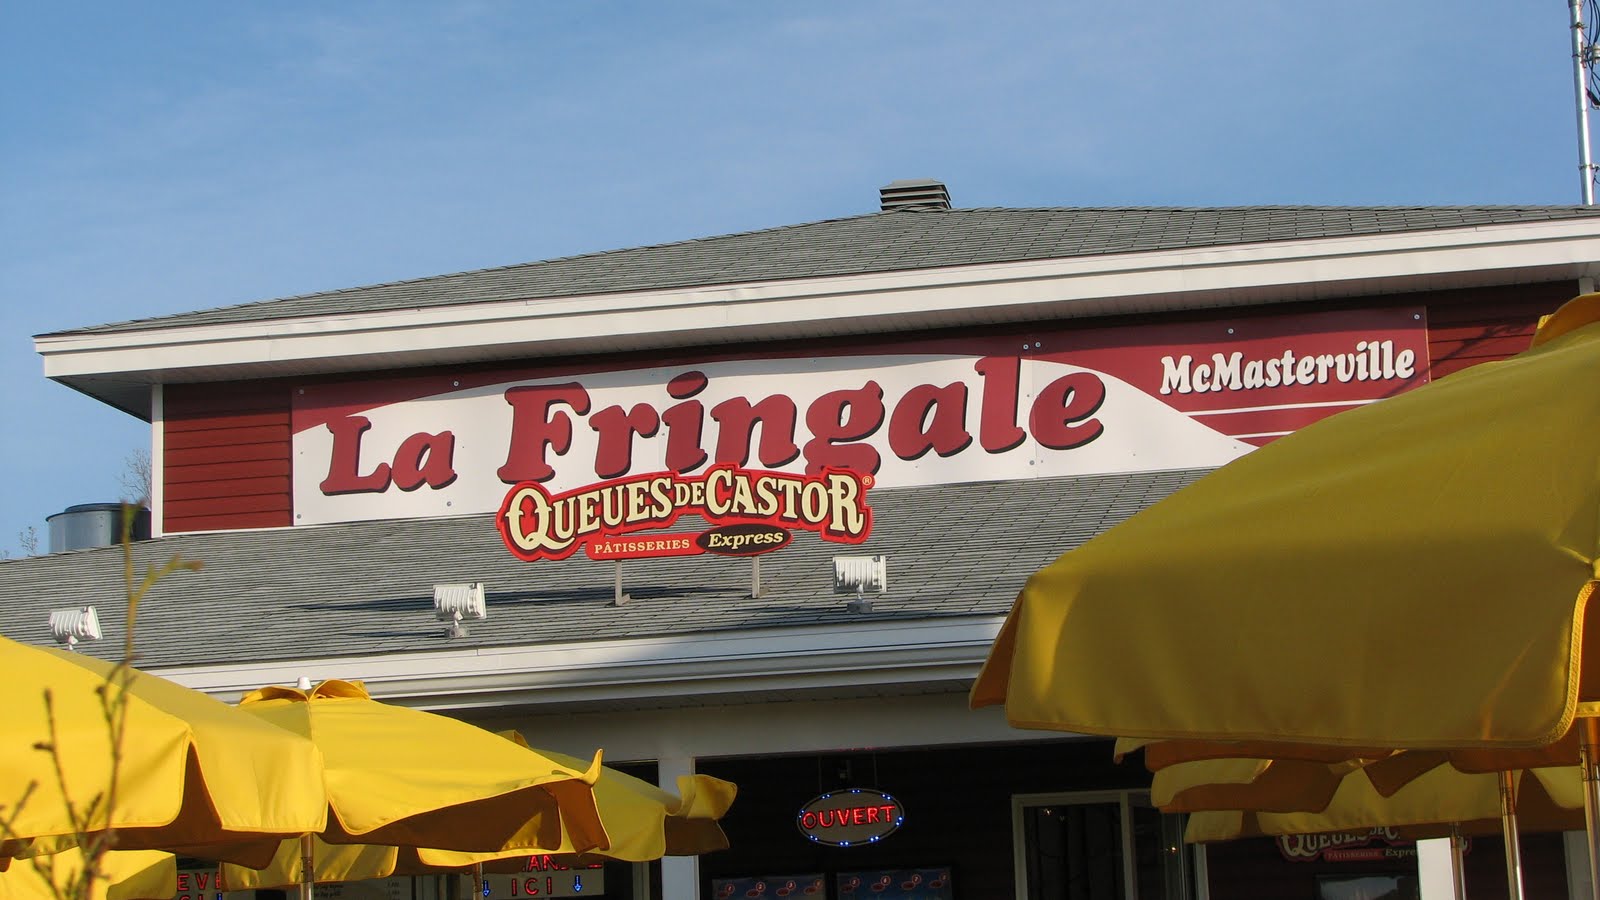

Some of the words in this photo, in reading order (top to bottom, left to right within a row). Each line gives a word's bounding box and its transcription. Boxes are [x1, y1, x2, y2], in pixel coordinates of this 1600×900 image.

[1160, 340, 1416, 396] McMasterville
[319, 415, 458, 496] La
[496, 355, 1106, 483] Fringale
[506, 476, 673, 551] QUEUES
[674, 482, 705, 507] DE
[705, 468, 864, 535] CASTOR
[594, 538, 691, 554] PÂTISSERIES
[707, 531, 784, 550] Express
[802, 804, 896, 829] OUVERT
[1385, 848, 1417, 858] Expre
[511, 877, 553, 896] ICI
